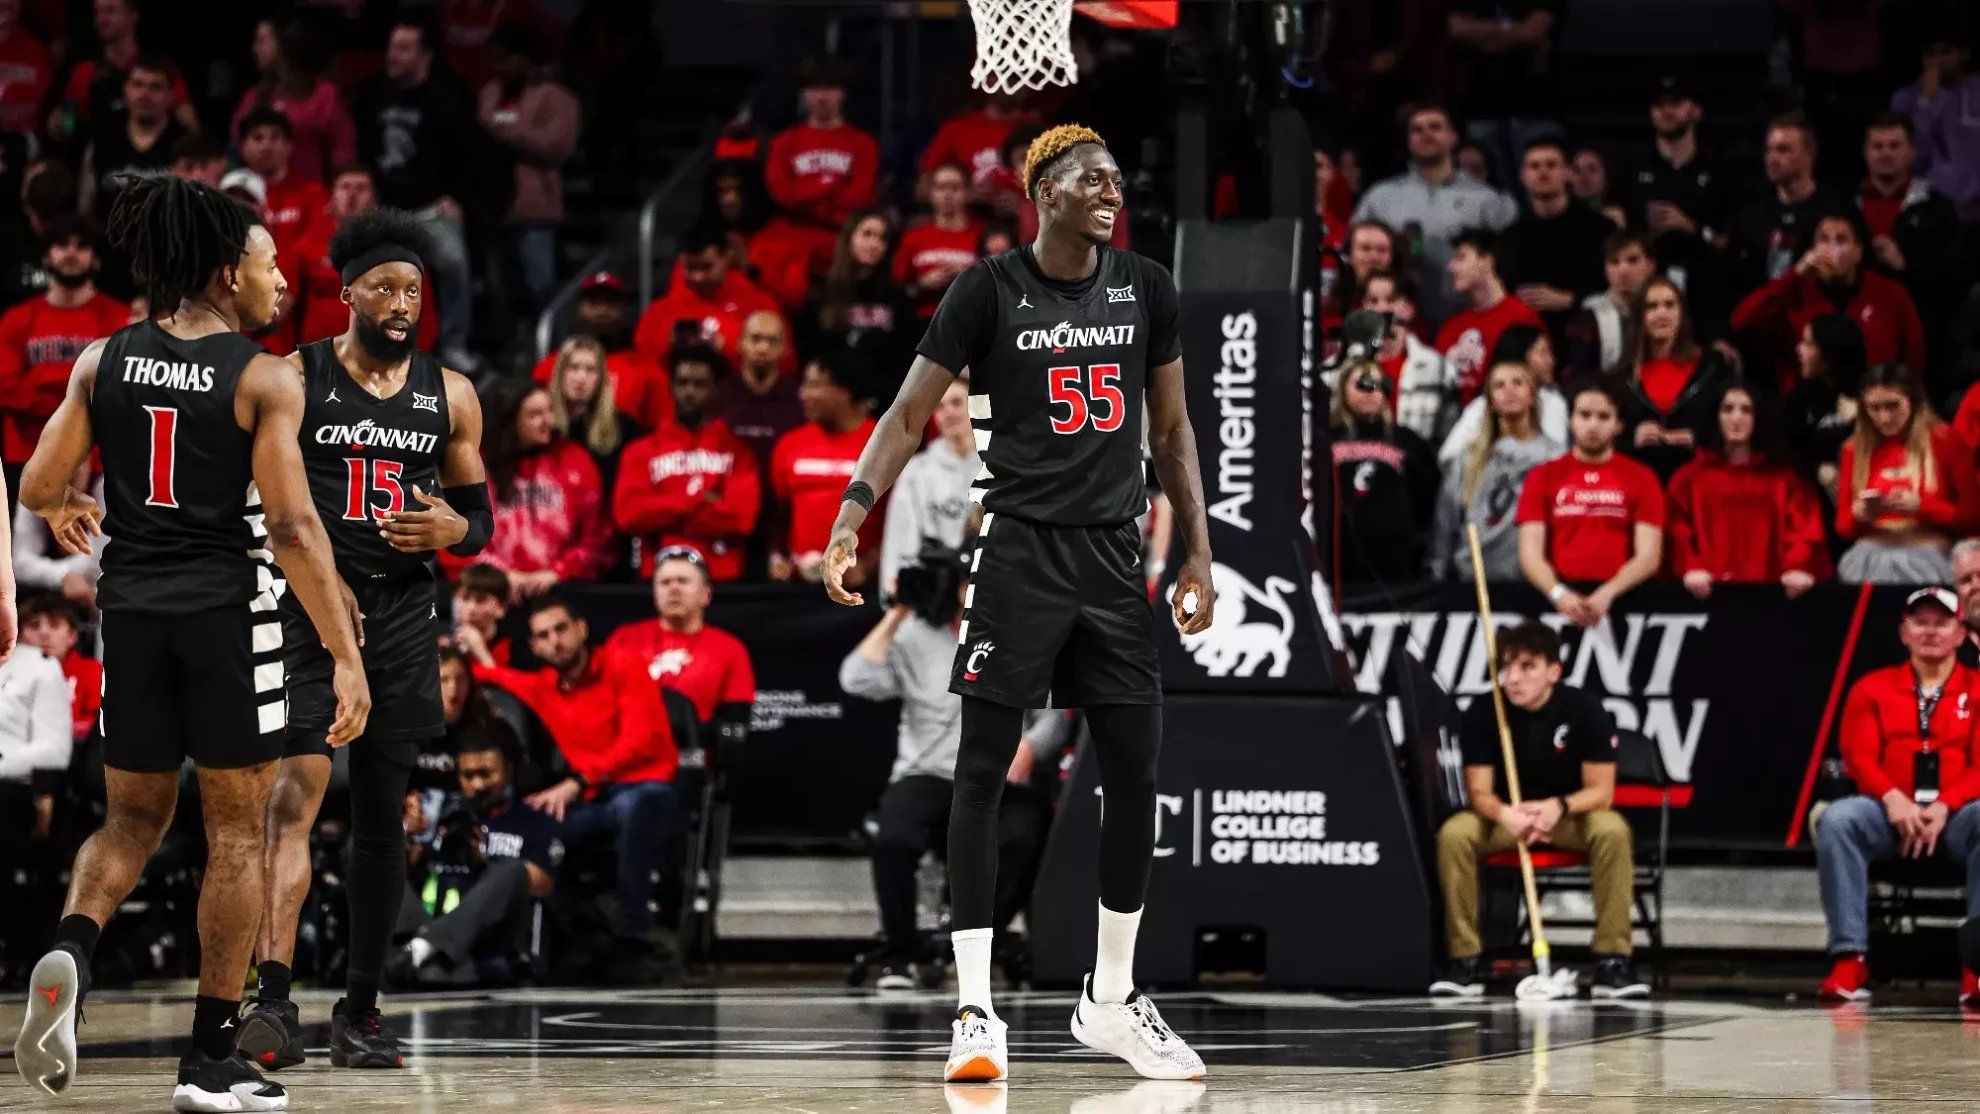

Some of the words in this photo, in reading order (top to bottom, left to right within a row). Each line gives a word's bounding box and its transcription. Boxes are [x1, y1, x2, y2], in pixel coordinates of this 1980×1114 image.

[1016, 321, 1135, 352] CINCINNATI
[123, 356, 215, 392] THOMAS
[1048, 363, 1125, 434] 55
[315, 419, 438, 453] CINCINNATI
[1208, 312, 1257, 531] Ameritas
[142, 405, 179, 508] 1
[342, 457, 404, 522] 15
[1212, 790, 1326, 814] LINDNER
[1211, 815, 1326, 839] COLLEGE
[1211, 840, 1250, 864] OF
[1252, 841, 1380, 865] BUSINESS
